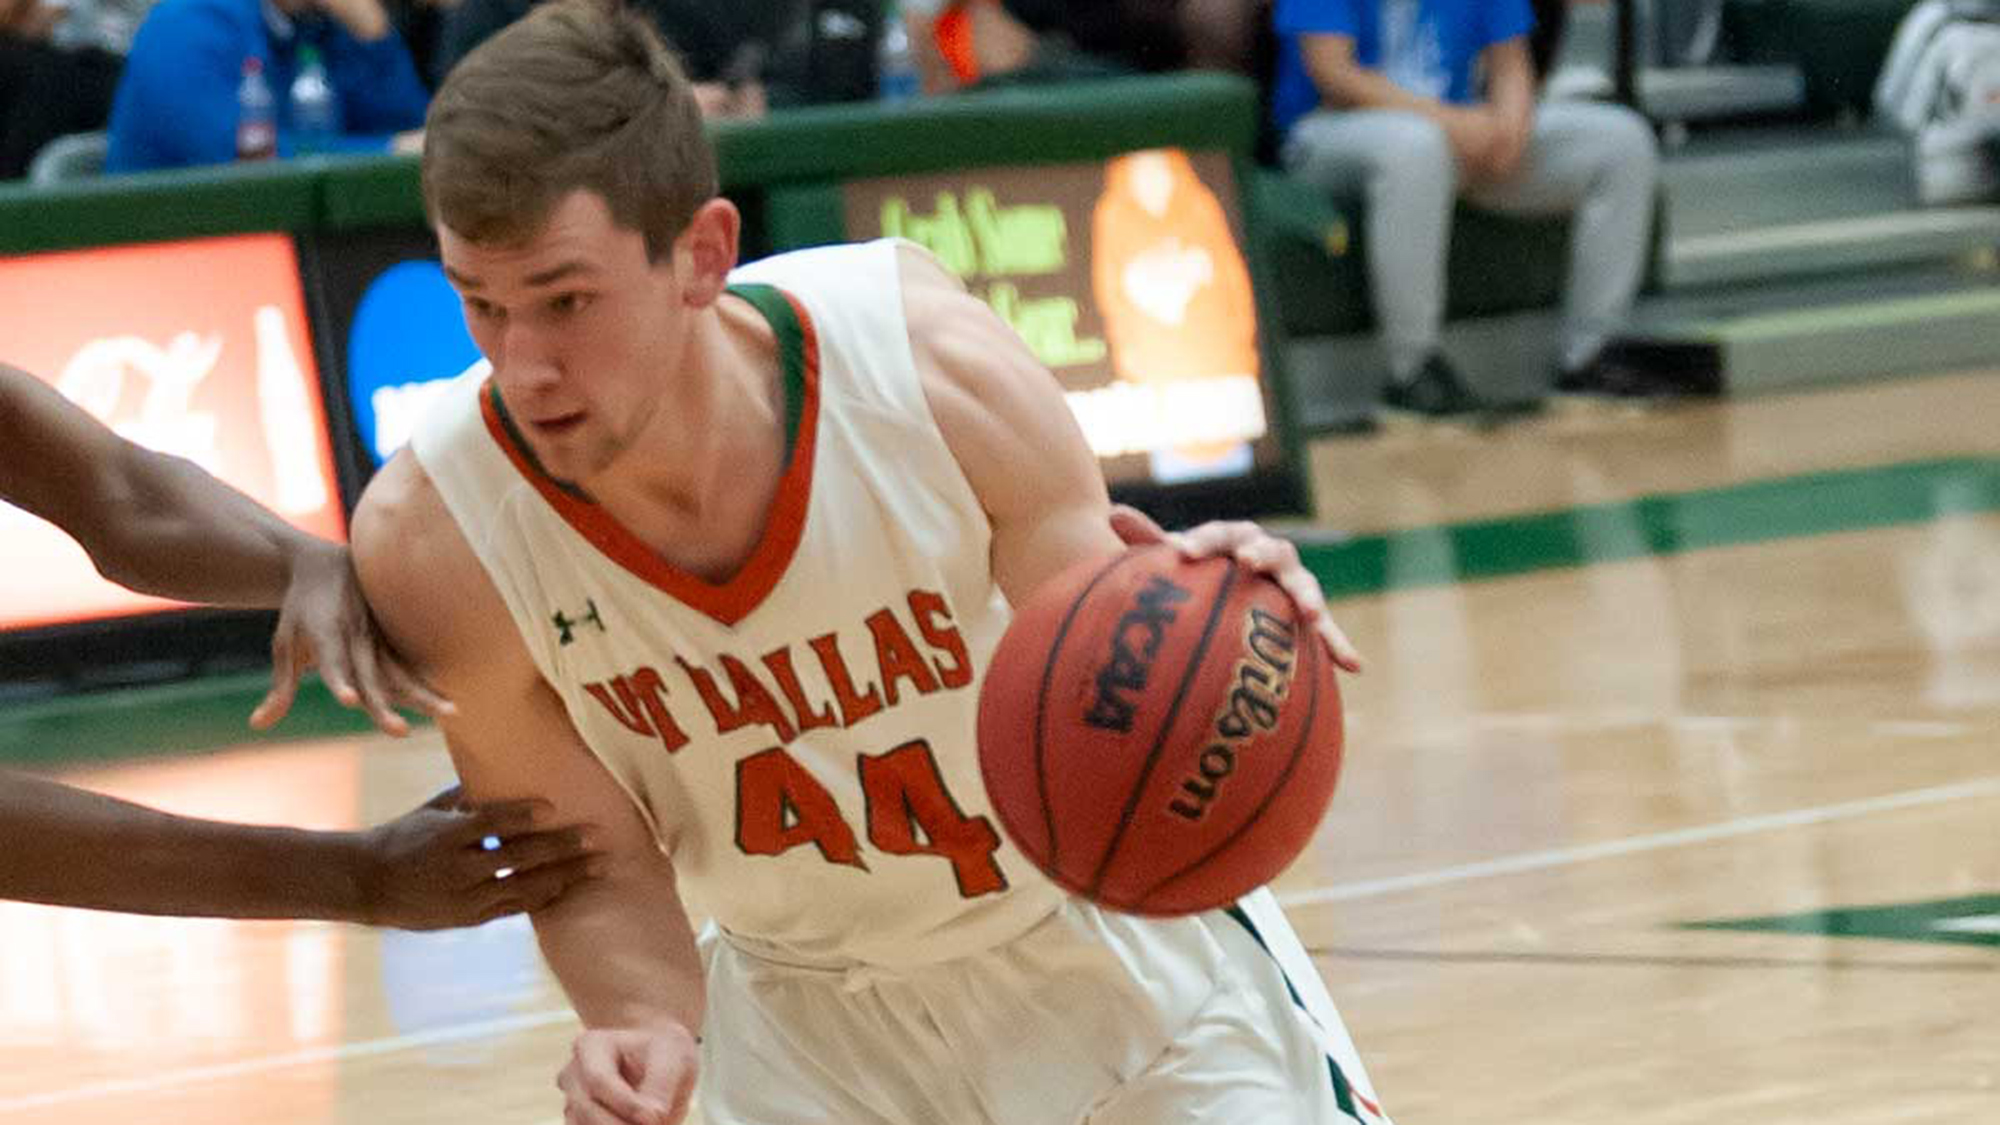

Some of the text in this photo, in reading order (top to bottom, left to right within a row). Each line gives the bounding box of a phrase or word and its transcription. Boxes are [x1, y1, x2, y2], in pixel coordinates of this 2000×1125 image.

[582, 667, 690, 753] UT
[1083, 575, 1193, 734] NCAA
[1168, 607, 1300, 820] Wilson
[734, 737, 1009, 899] 44
